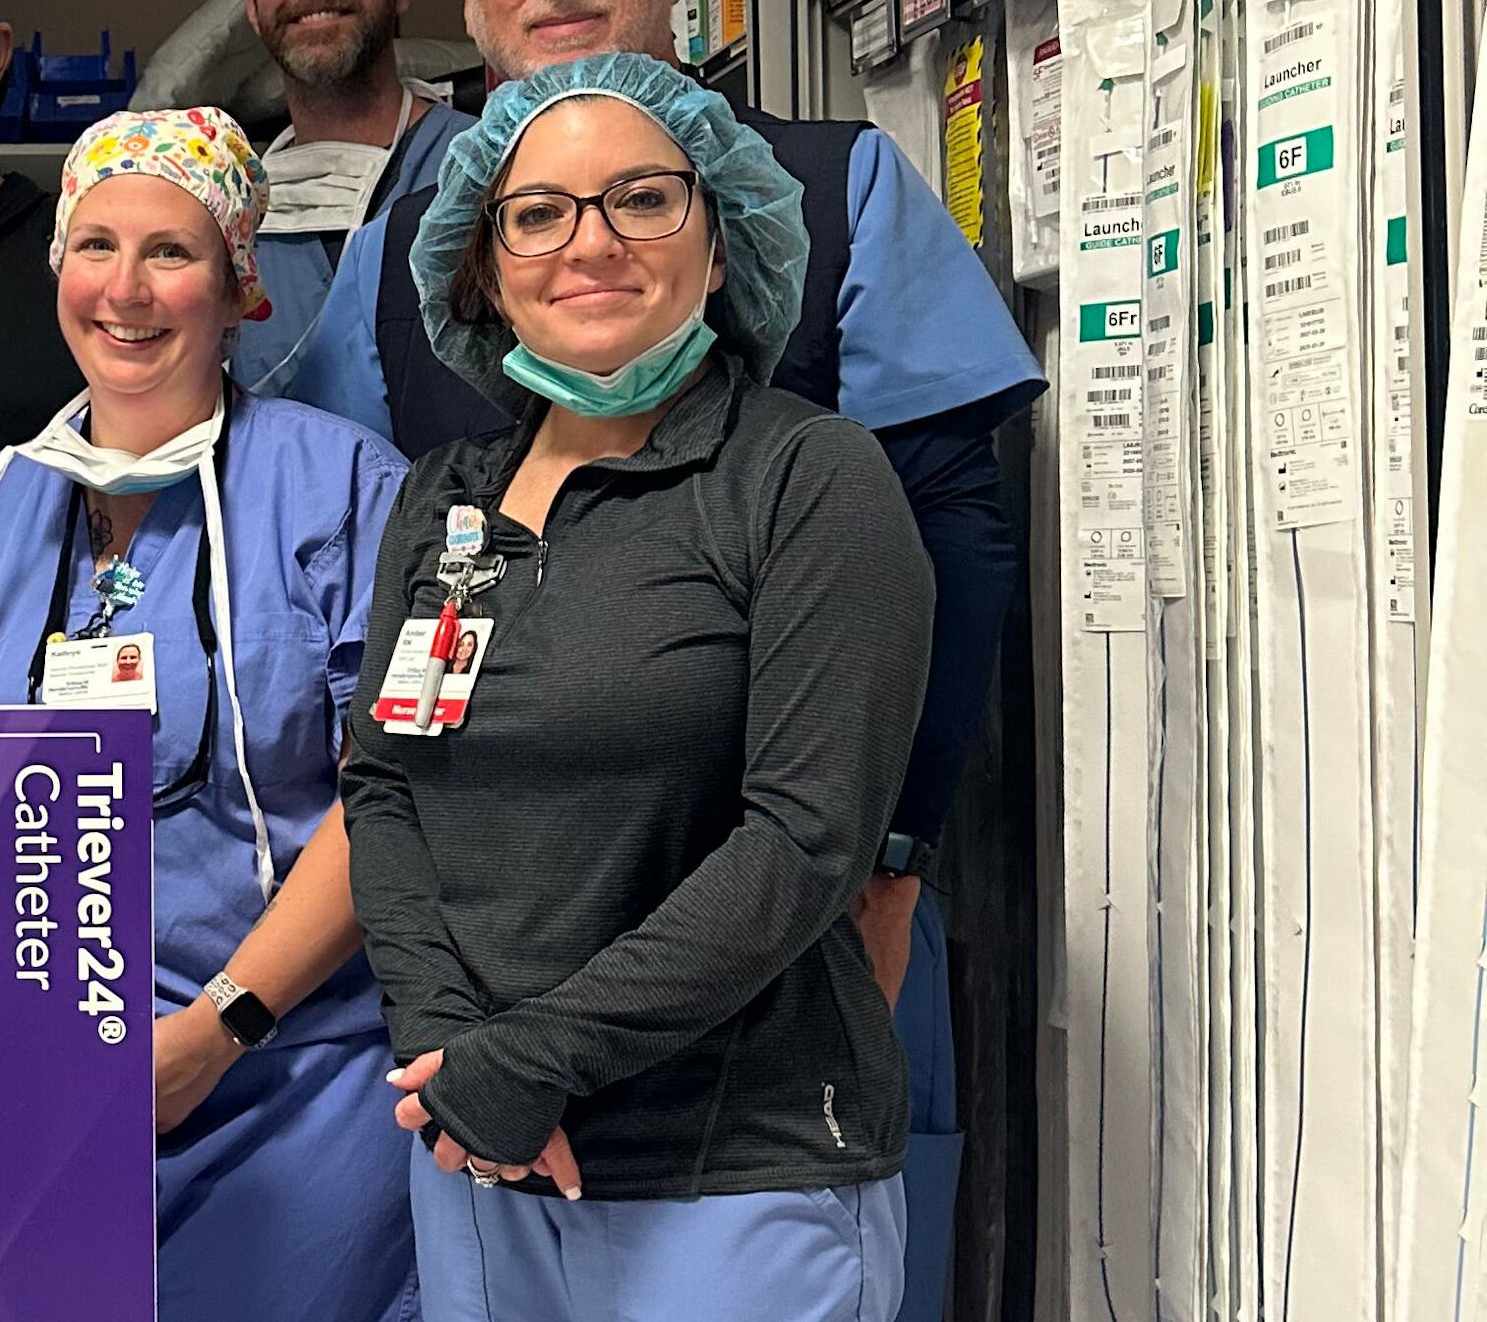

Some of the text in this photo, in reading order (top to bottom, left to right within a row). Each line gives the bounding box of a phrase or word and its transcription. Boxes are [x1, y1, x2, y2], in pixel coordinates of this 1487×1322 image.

[1263, 58, 1323, 89] Launcher
[1279, 145, 1303, 170] 6F
[1084, 218, 1143, 237] Launch
[1085, 239, 1111, 250] GUIDE
[1108, 311, 1138, 327] 6Fr
[14, 764, 62, 991] Catheter
